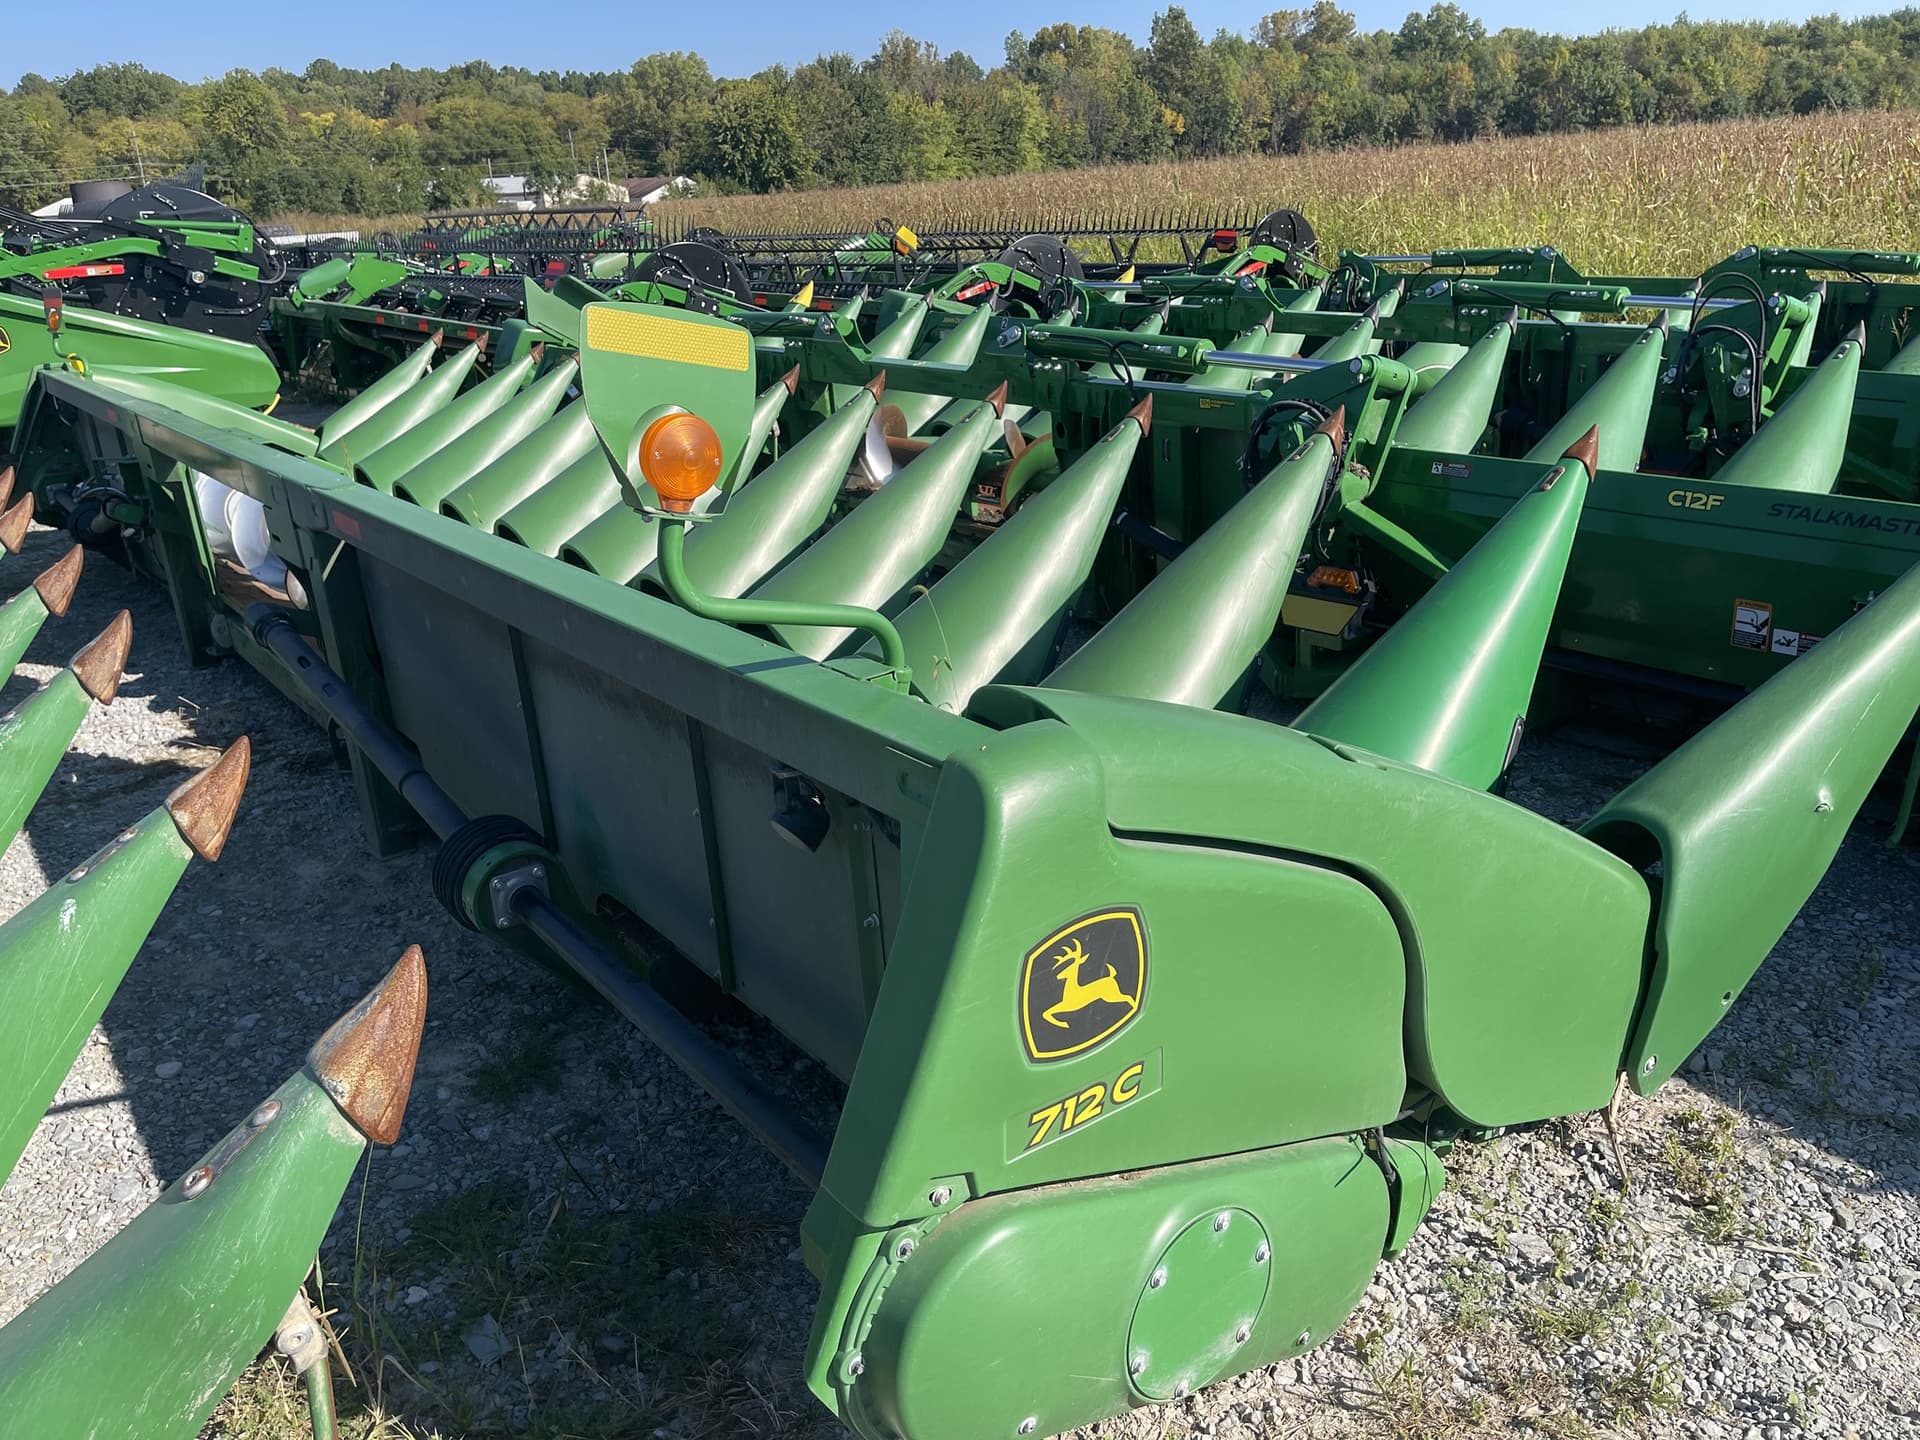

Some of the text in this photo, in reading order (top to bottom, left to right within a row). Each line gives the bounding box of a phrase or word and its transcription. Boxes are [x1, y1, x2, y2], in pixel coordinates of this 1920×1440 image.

[1667, 490, 1725, 511] C12F
[1767, 503, 1920, 537] STALKMAST
[1025, 1061, 1143, 1151] 712 C
